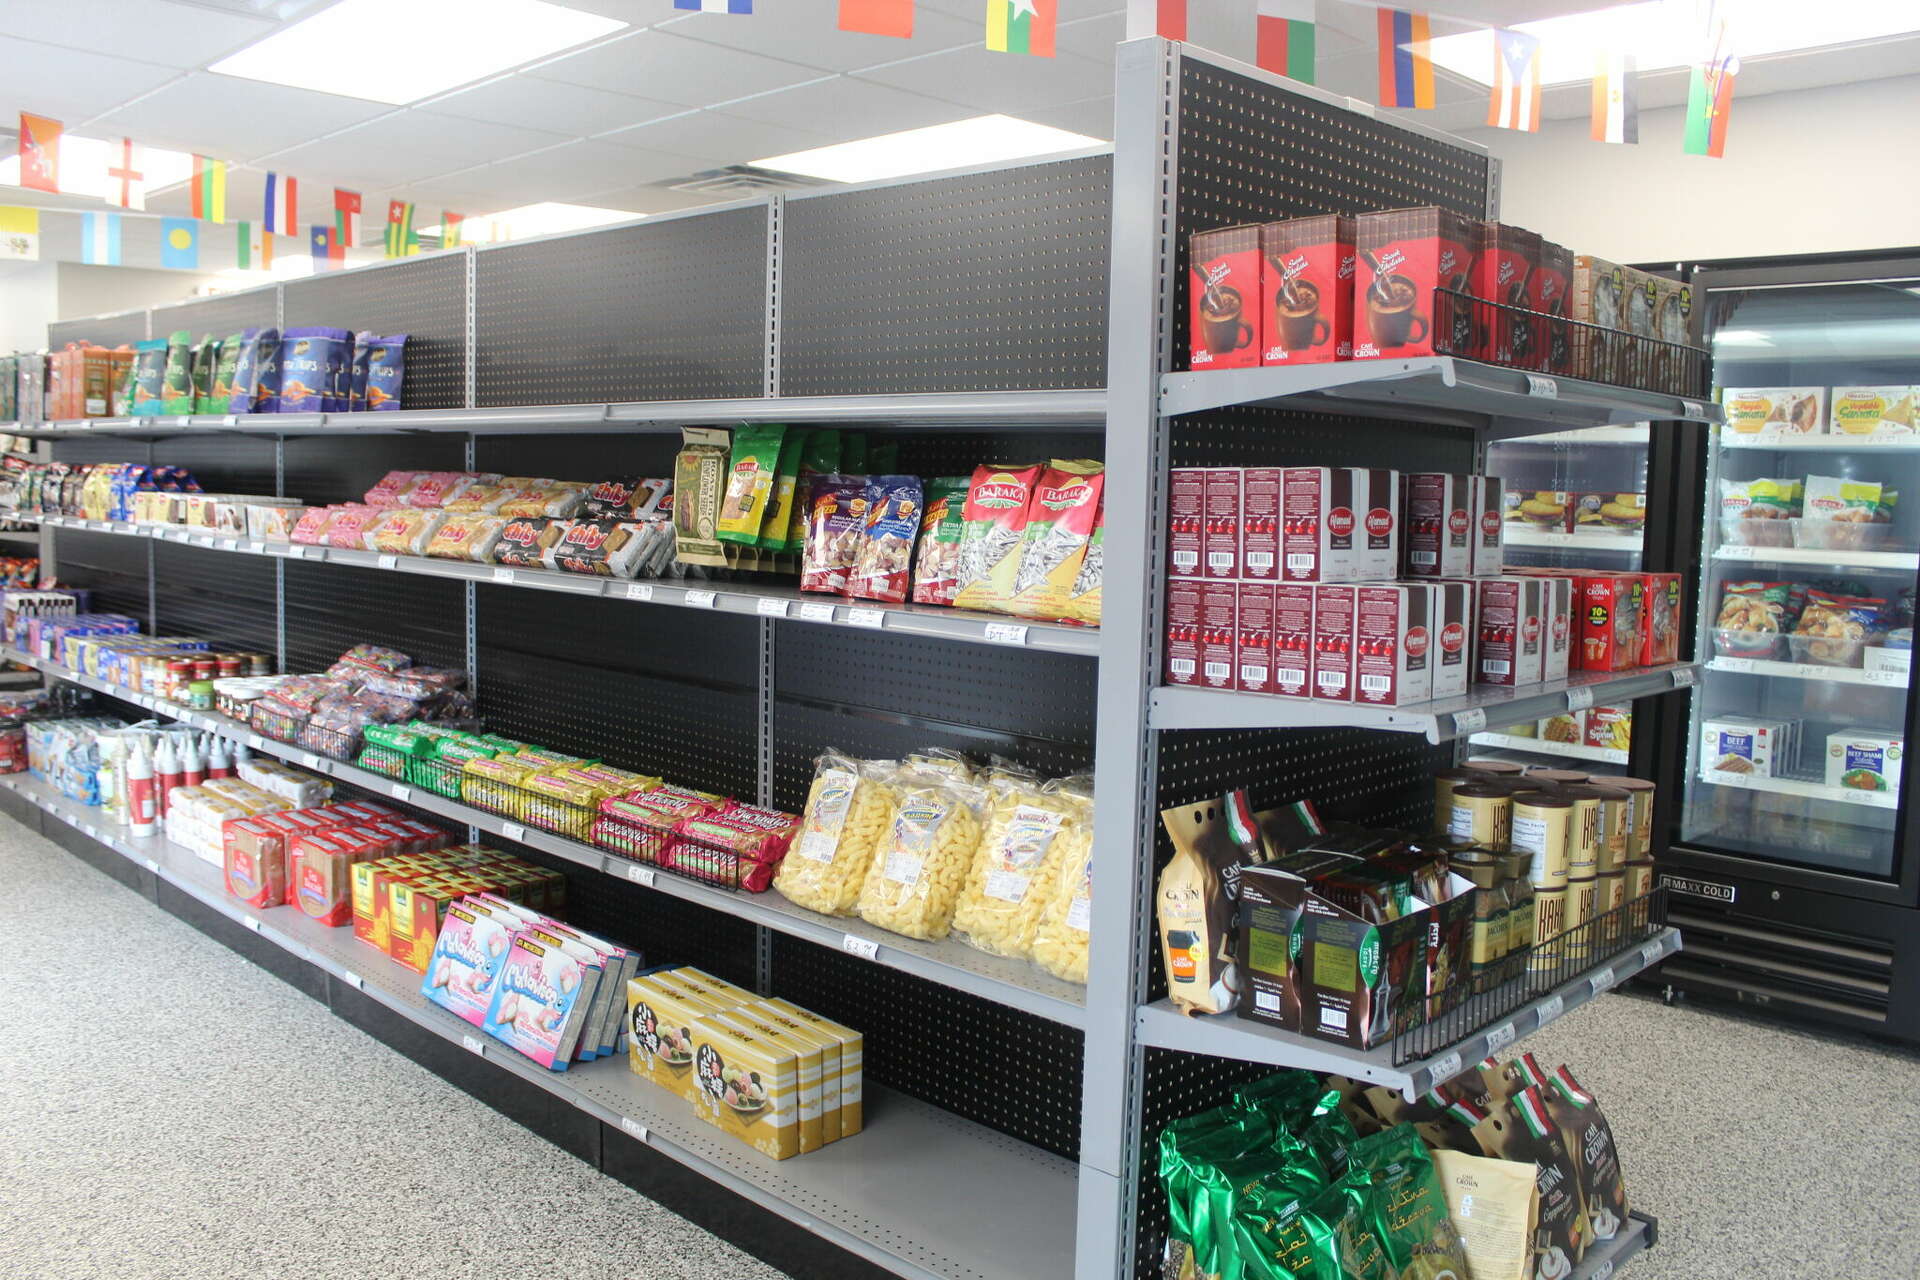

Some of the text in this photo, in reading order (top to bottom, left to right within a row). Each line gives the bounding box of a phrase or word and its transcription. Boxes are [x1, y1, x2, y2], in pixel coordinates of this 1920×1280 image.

[1266, 351, 1288, 360] CROWN
[1355, 348, 1380, 357] CROWN
[978, 485, 1025, 501] BARAKA
[1046, 487, 1088, 501] BARAKA
[1587, 588, 1610, 596] CROWN
[1727, 736, 1746, 745] BEEF
[1672, 879, 1731, 898] MAXX COLD
[1585, 1129, 1609, 1165] CROWN
[1456, 1178, 1479, 1188] CROWN
